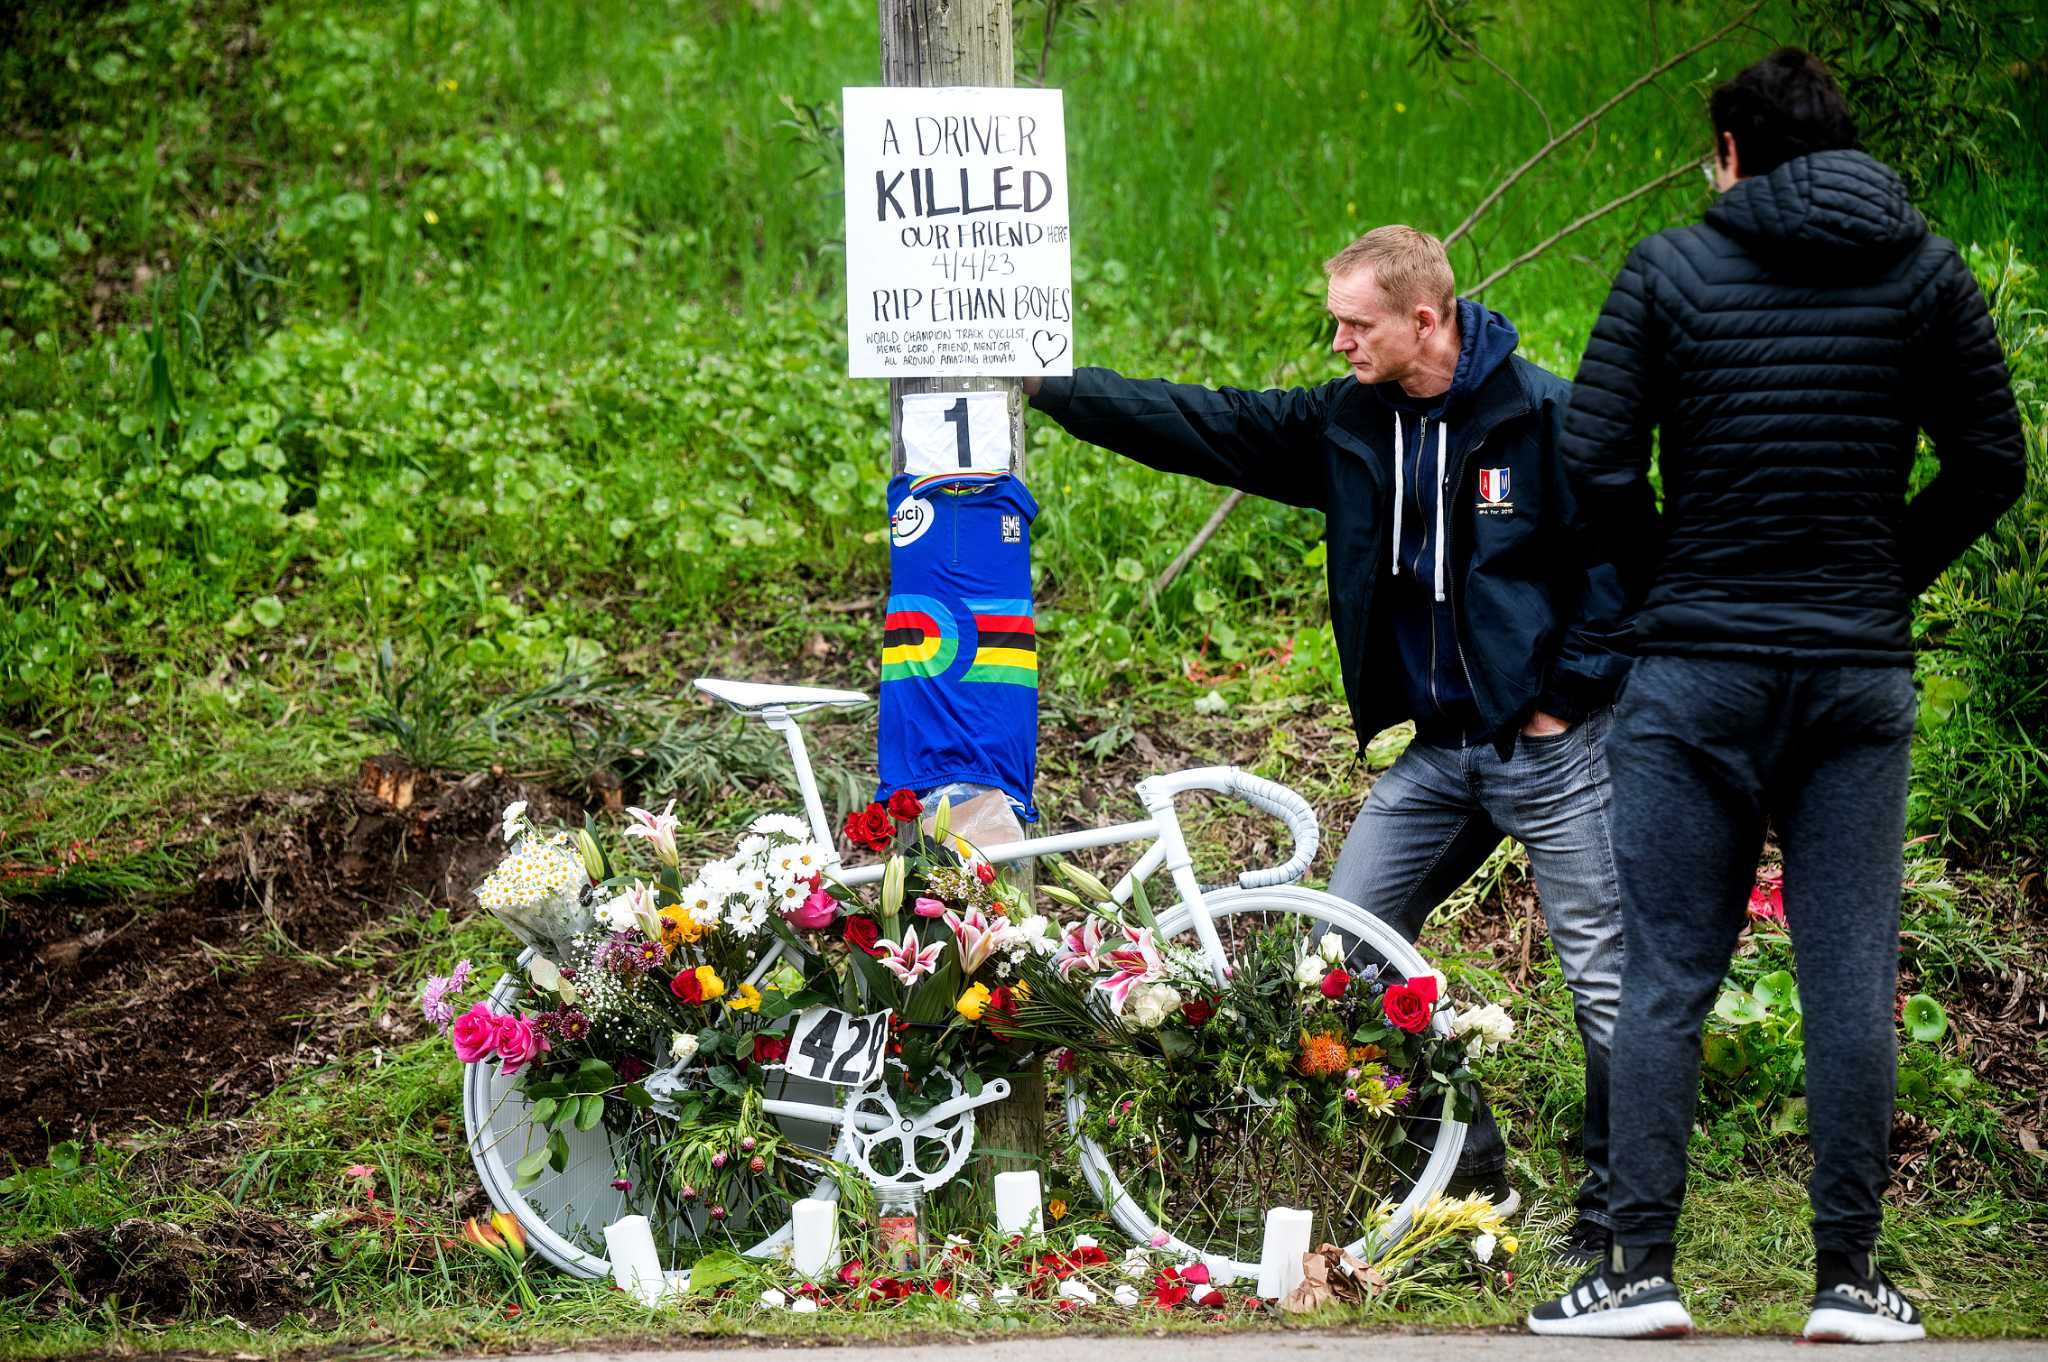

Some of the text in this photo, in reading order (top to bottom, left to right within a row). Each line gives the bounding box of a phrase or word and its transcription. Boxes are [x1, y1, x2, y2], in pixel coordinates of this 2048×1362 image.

[883, 115, 1036, 157] A DRIVER
[875, 165, 1053, 222] KILLED
[901, 220, 1068, 249] OUR FRIEND HERE
[931, 249, 1015, 282] 4/4/23
[873, 285, 1070, 322] RIP ETHAN BOYES
[866, 331, 899, 344] WORLD
[903, 329, 951, 343] CHAMPION
[955, 328, 983, 340] TRACK
[876, 344, 902, 354] MEME
[884, 353, 1016, 366] ALL AROUND AMAZING HUMAN
[944, 397, 972, 468] 1
[799, 1009, 887, 1083] 429
